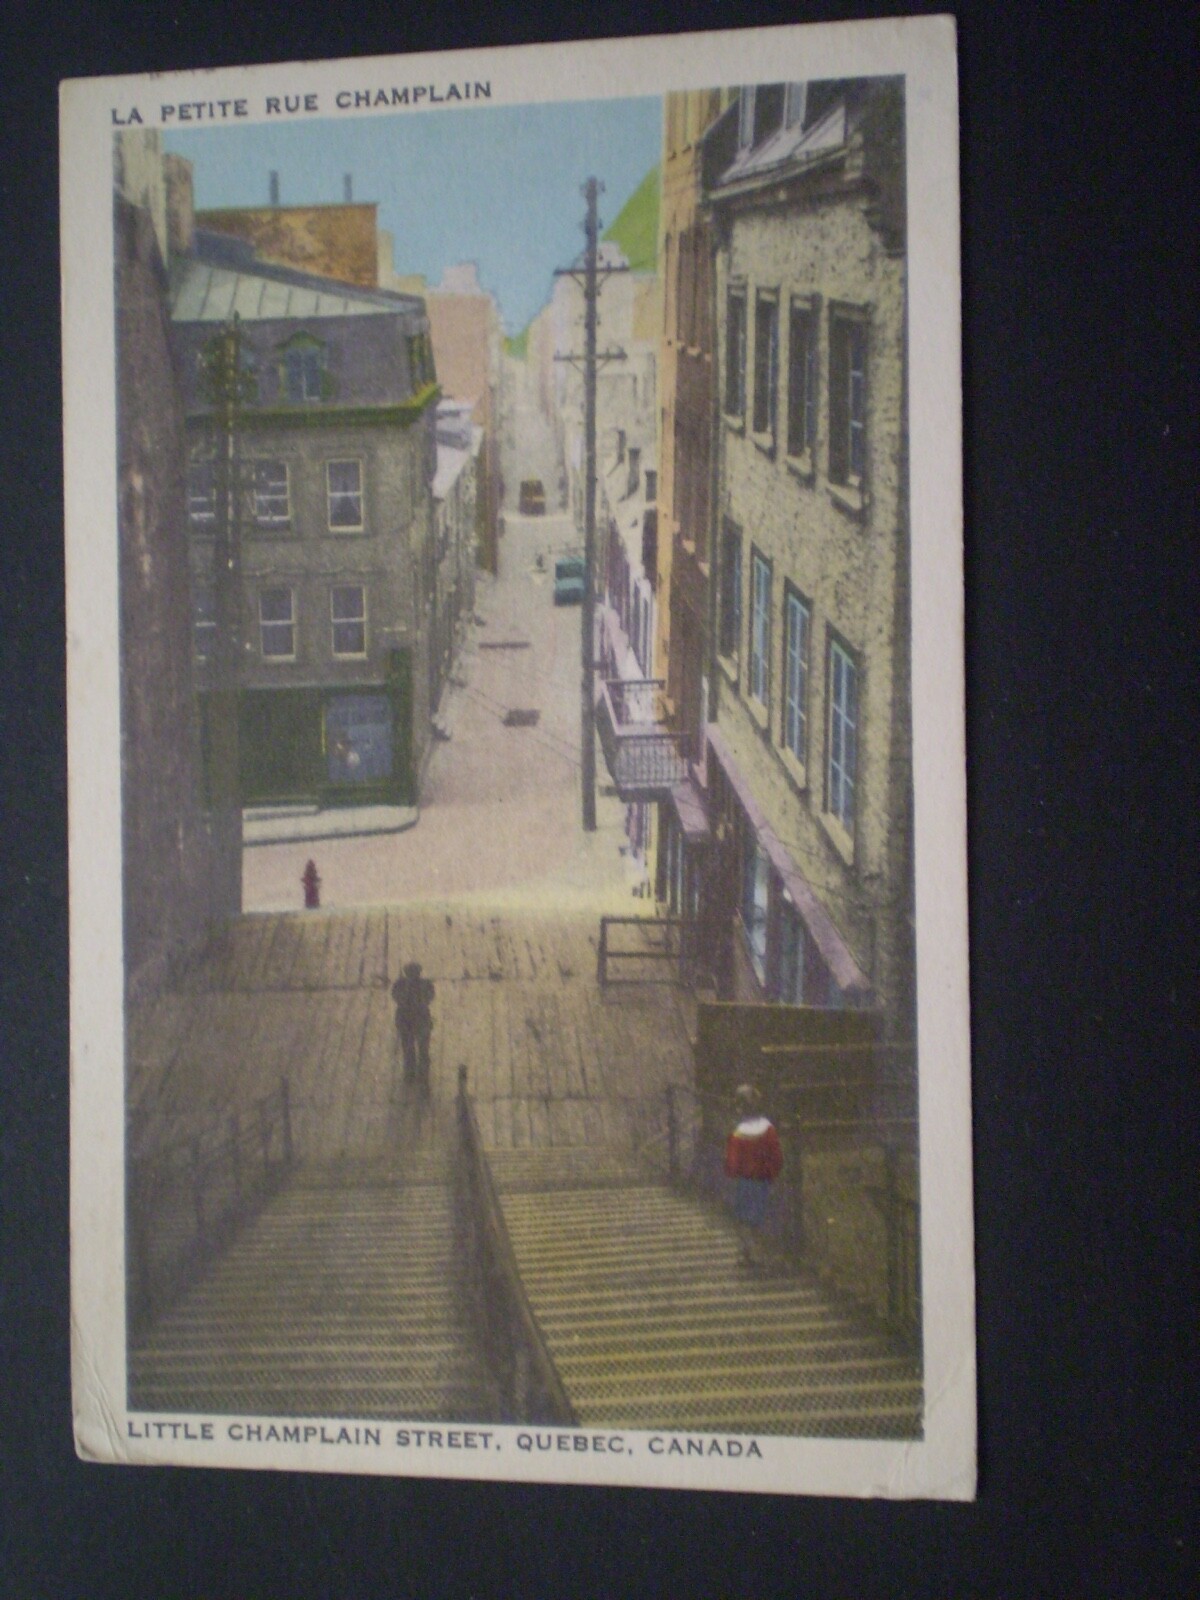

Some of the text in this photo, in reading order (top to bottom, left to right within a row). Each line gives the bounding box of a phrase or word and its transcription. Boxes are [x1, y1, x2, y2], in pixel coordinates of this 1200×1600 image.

[111, 81, 491, 125] LA PETITE RUE CHAMPLAIN
[128, 1421, 763, 1458] LITTLE CHAMPLAIN STREET, QUEBEC, CANADA
